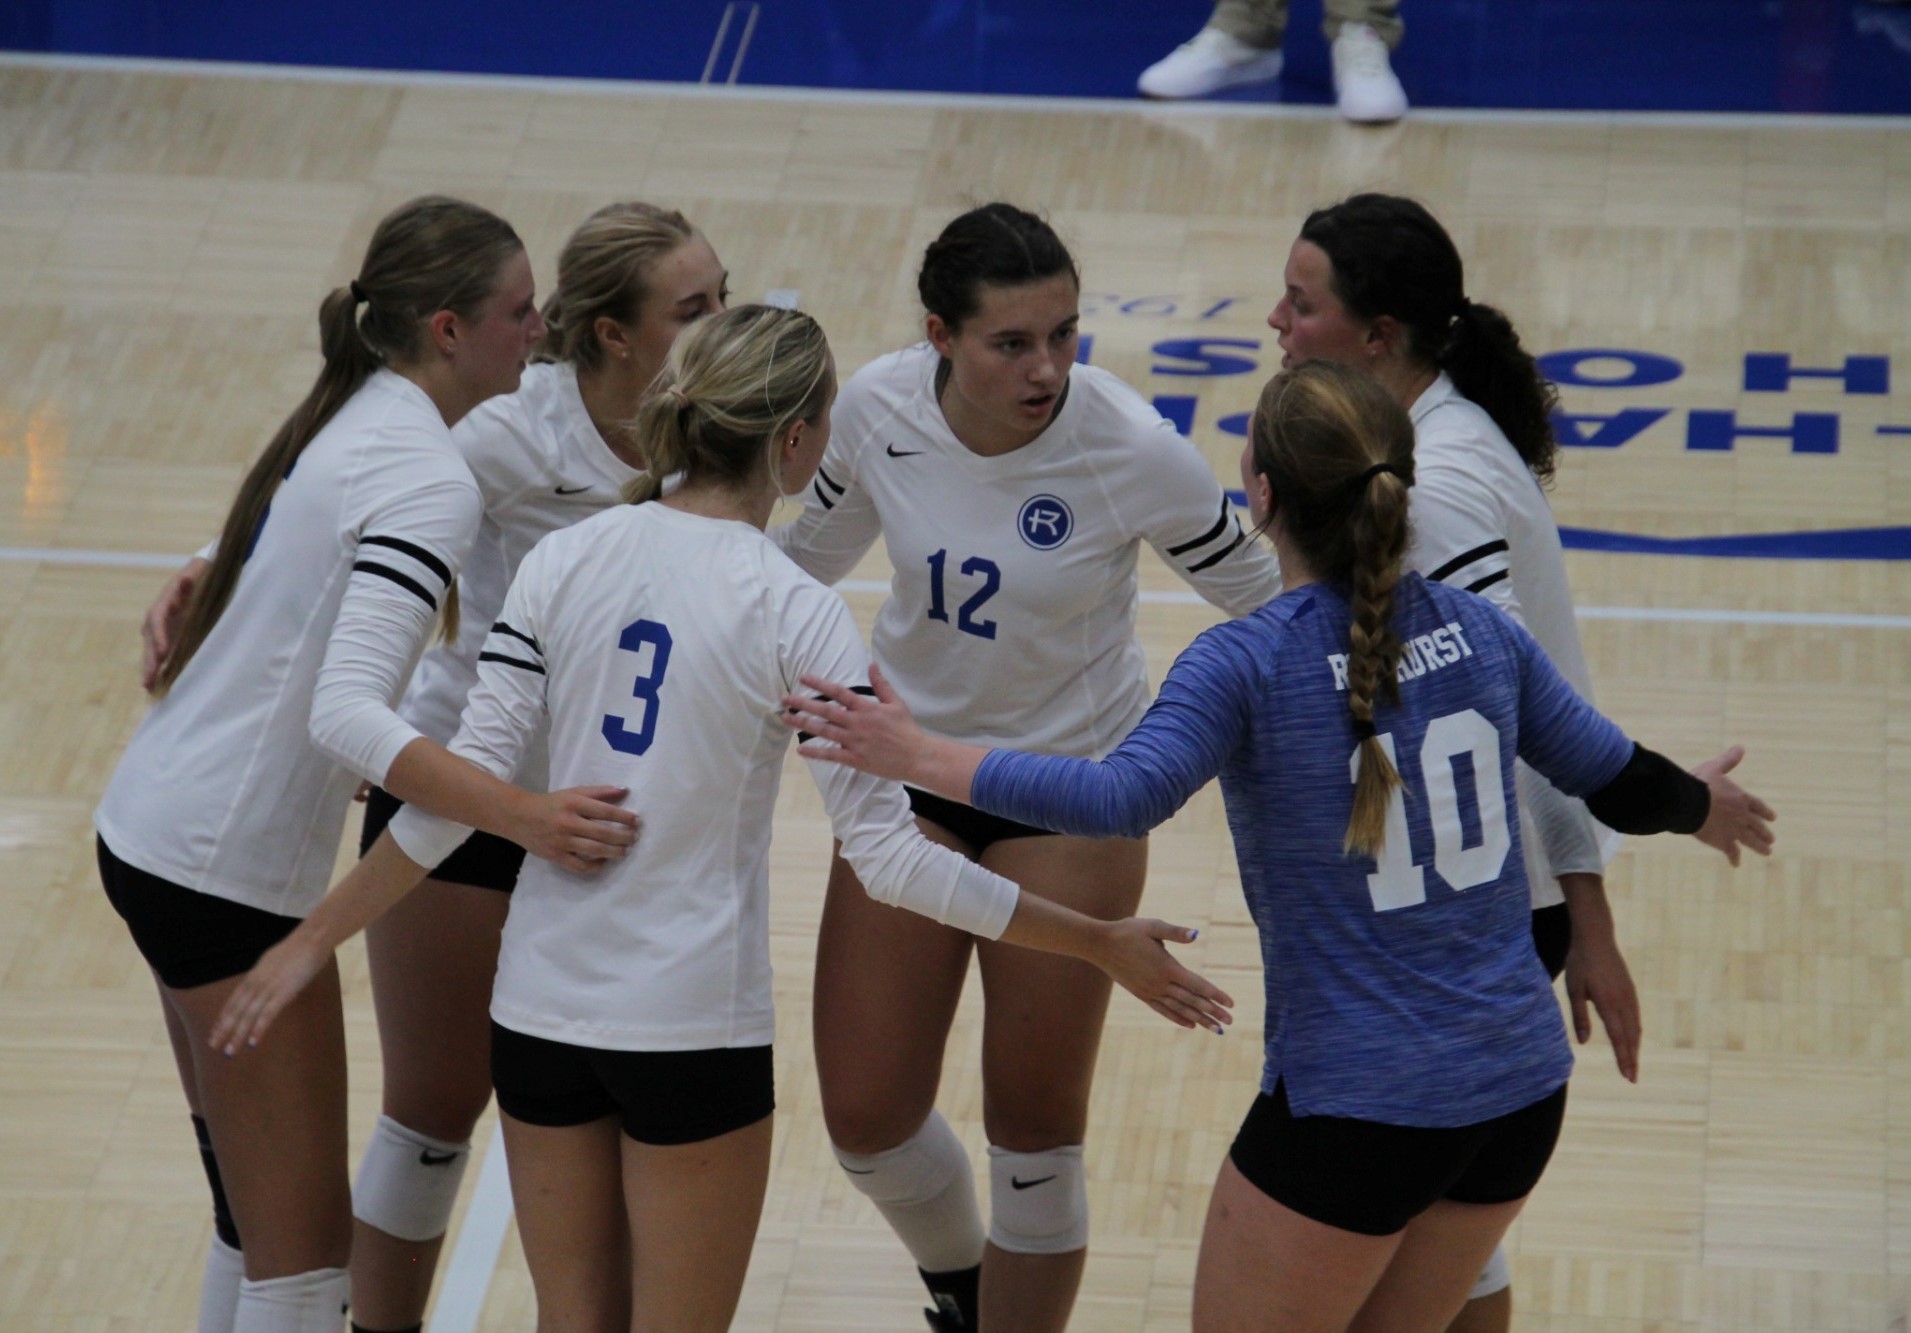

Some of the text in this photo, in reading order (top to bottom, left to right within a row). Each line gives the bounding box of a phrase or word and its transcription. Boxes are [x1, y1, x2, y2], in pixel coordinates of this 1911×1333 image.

[927, 548, 1001, 640] 12
[601, 618, 673, 756] 3
[1328, 622, 1473, 690] RHURST
[1349, 708, 1512, 912] 10
